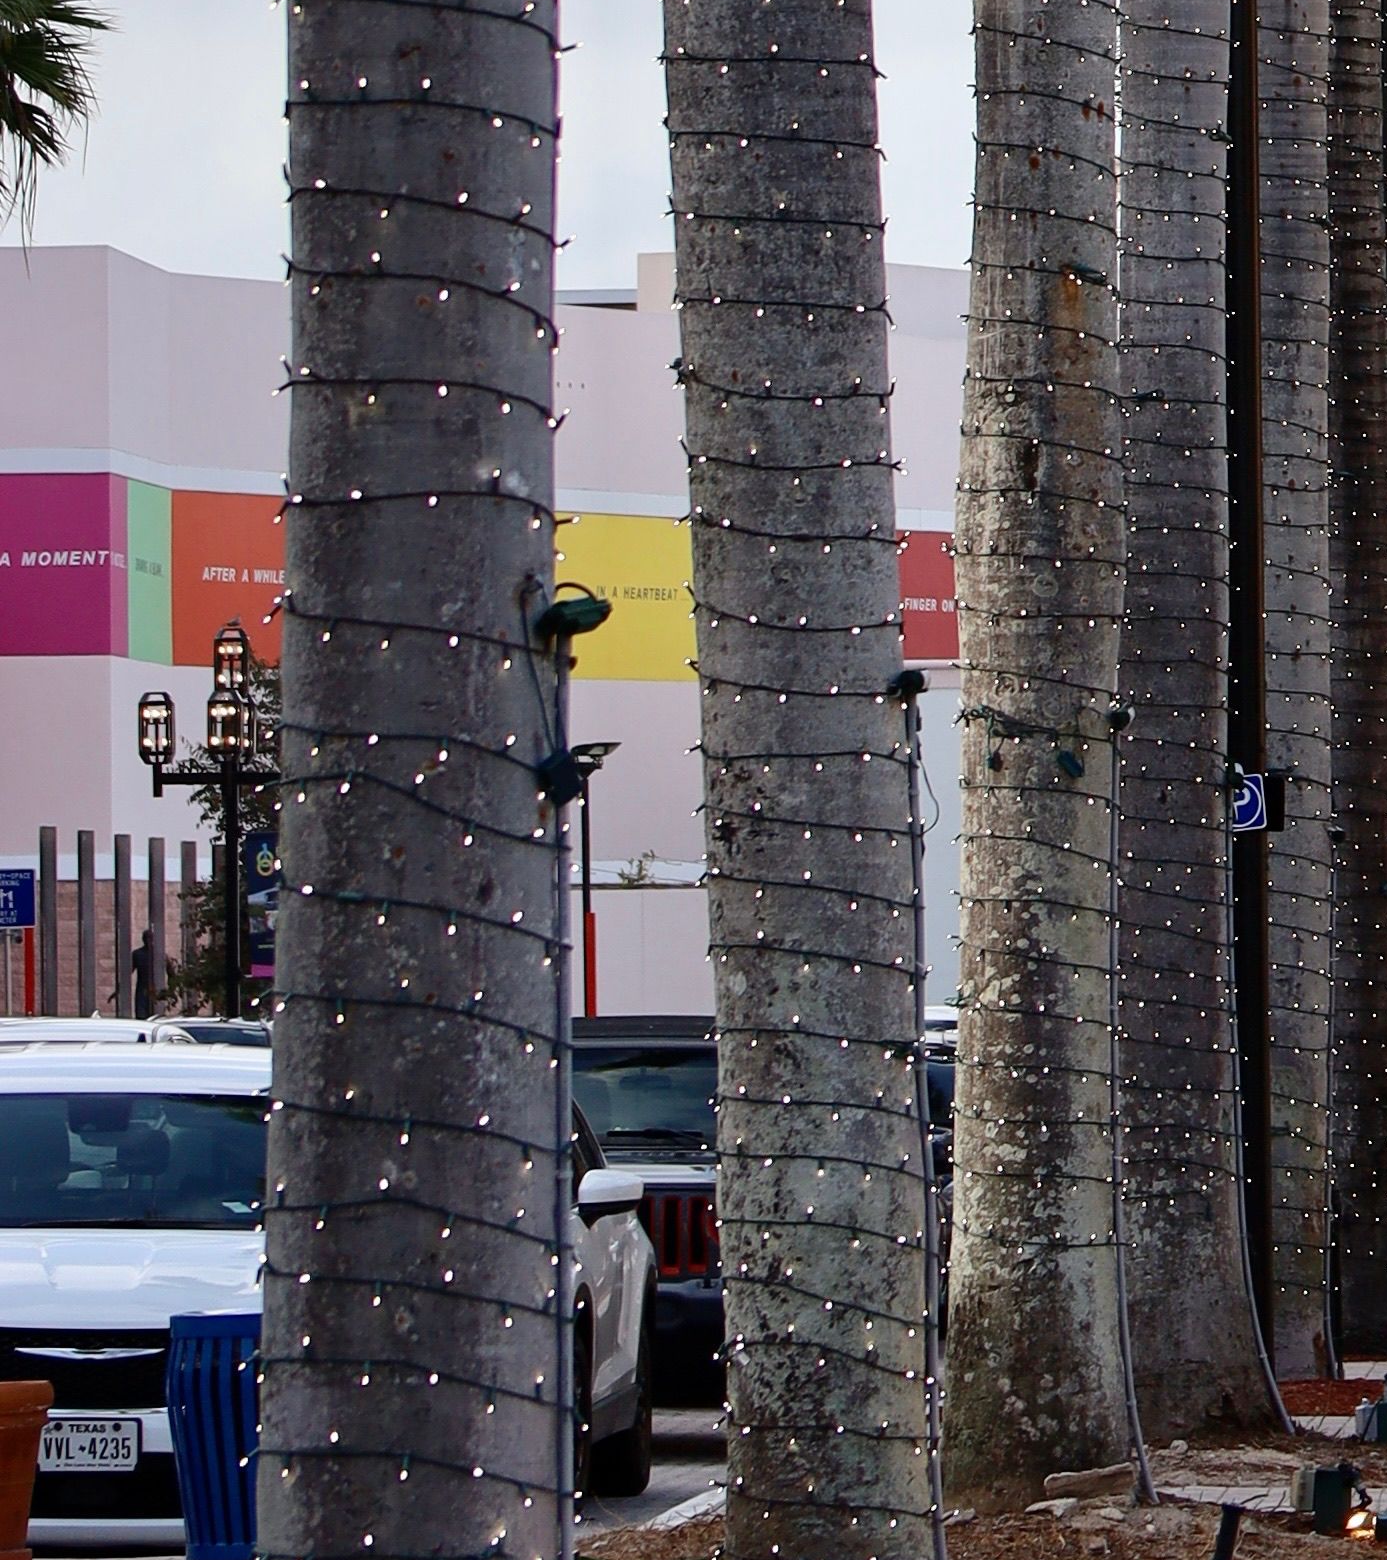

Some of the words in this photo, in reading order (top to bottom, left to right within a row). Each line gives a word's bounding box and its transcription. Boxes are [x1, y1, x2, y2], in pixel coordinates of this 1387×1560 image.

[21, 550, 109, 567] MOMENT
[202, 566, 236, 582] AFTER
[241, 568, 249, 583] A
[254, 569, 285, 584] WHILE
[596, 586, 606, 597] IN
[612, 586, 618, 598] A
[624, 587, 678, 601] HEARTBEAT
[904, 598, 937, 611] FINGER
[942, 599, 955, 612] ON
[68, 1423, 106, 1433] TEXAS
